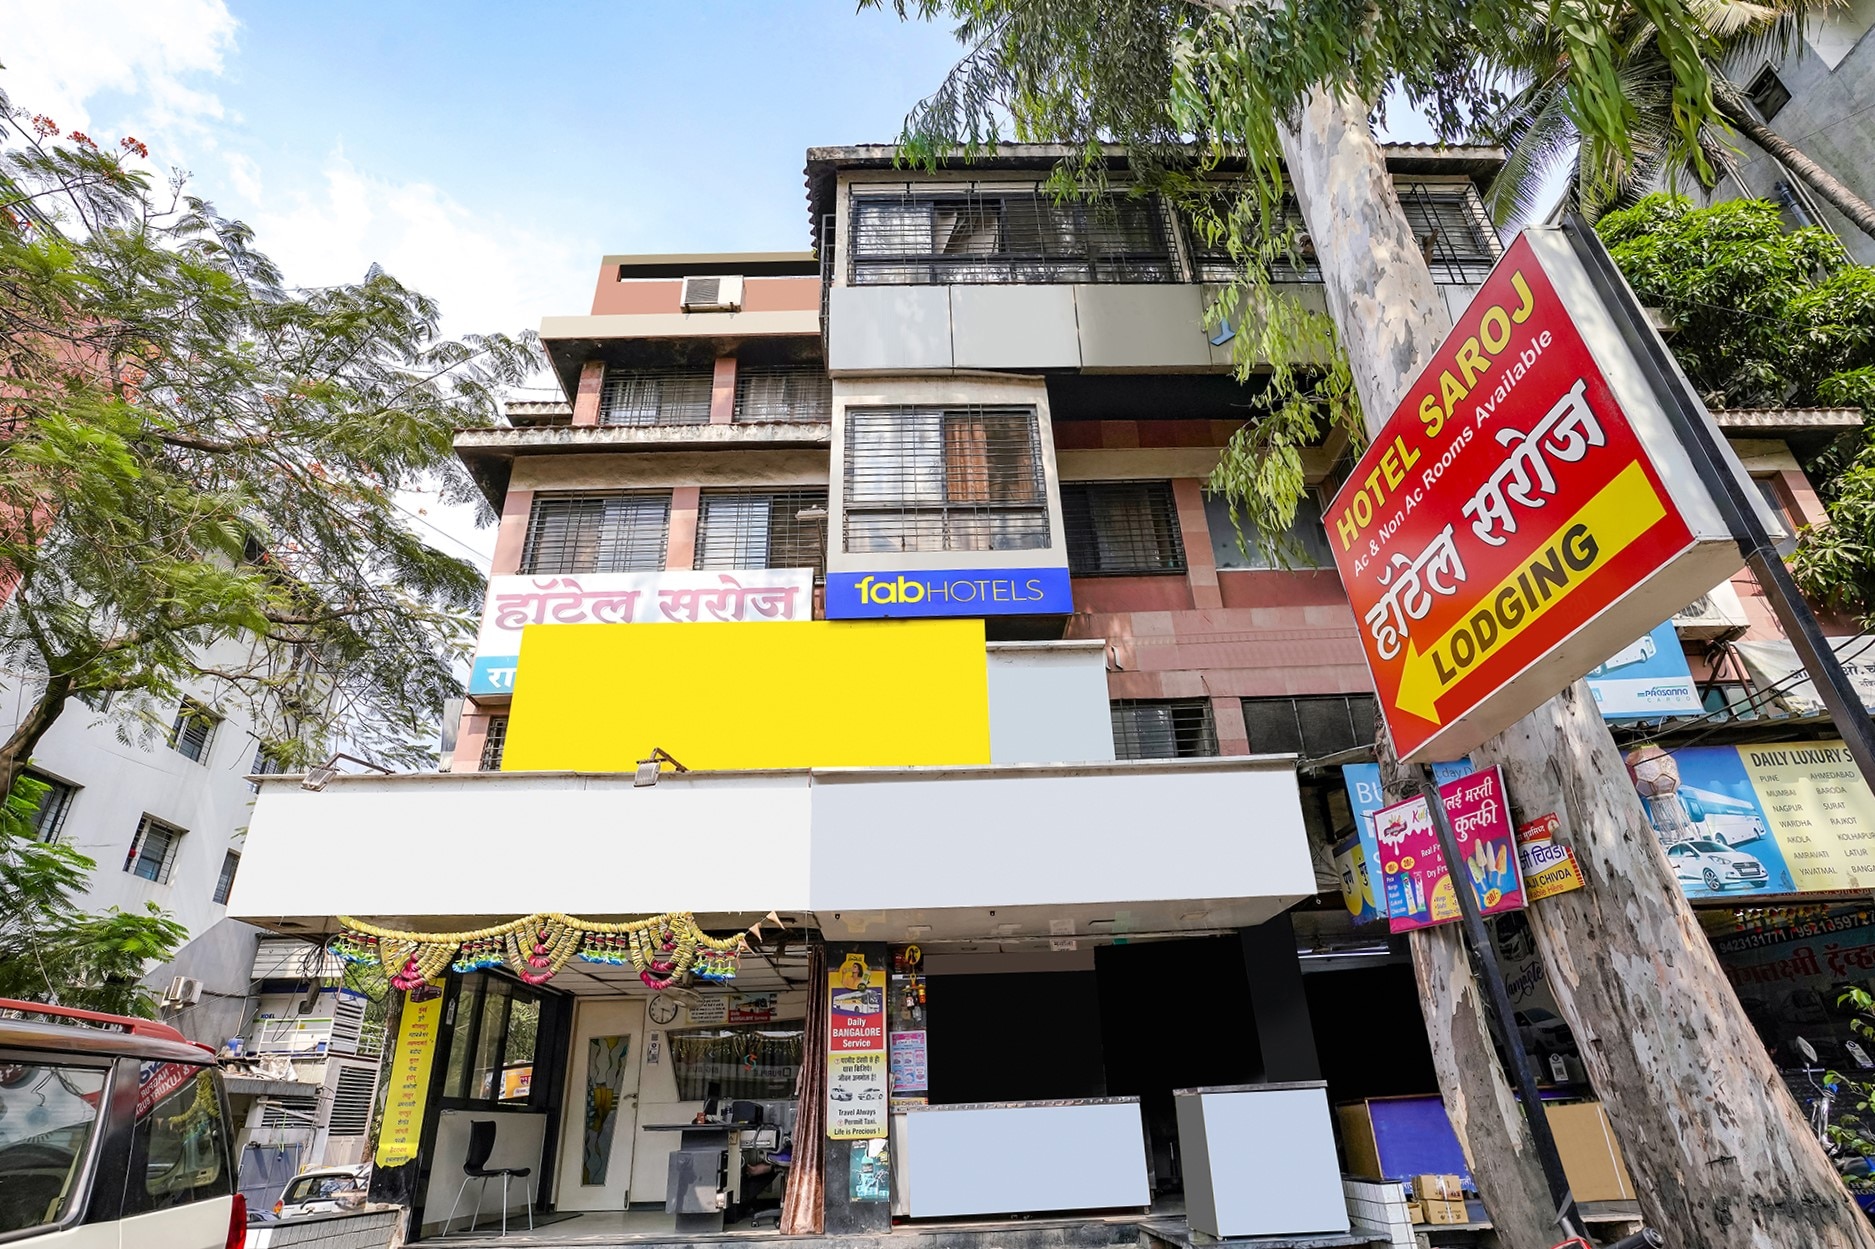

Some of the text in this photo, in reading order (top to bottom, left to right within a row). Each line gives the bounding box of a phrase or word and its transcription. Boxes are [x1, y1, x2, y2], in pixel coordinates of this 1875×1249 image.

[1336, 270, 1535, 551] HOTEL SAROJ
[1354, 329, 1553, 577] Ac & Non Ac Rooms Available
[1364, 377, 1606, 661] हॉटेल सरोज
[495, 575, 801, 631] हॉटेल सरोज
[1431, 523, 1600, 686] LODGING
[1750, 748, 1853, 767] DAILY LUXURY S
[1810, 771, 1855, 780] AHMEDABAD
[1465, 776, 1493, 802] मस्ती
[1816, 787, 1847, 795] BARODA
[1823, 802, 1846, 810] SURAT
[1454, 799, 1498, 842] कुल्फी
[1779, 820, 1812, 828] WARDHA
[1830, 817, 1857, 825] RAJKOT
[1793, 851, 1829, 859] AMRAVATI
[1844, 849, 1868, 857] LATUR
[1800, 867, 1838, 875] YAVATMAL
[1851, 865, 1875, 873] BANGA
[1540, 868, 1572, 886] CHIVDA
[1547, 883, 1564, 892] Here
[1720, 930, 1787, 953] 9423131771
[847, 1018, 866, 1027] Daily
[833, 1027, 881, 1037] BANGALORE
[842, 1039, 871, 1048] Service
